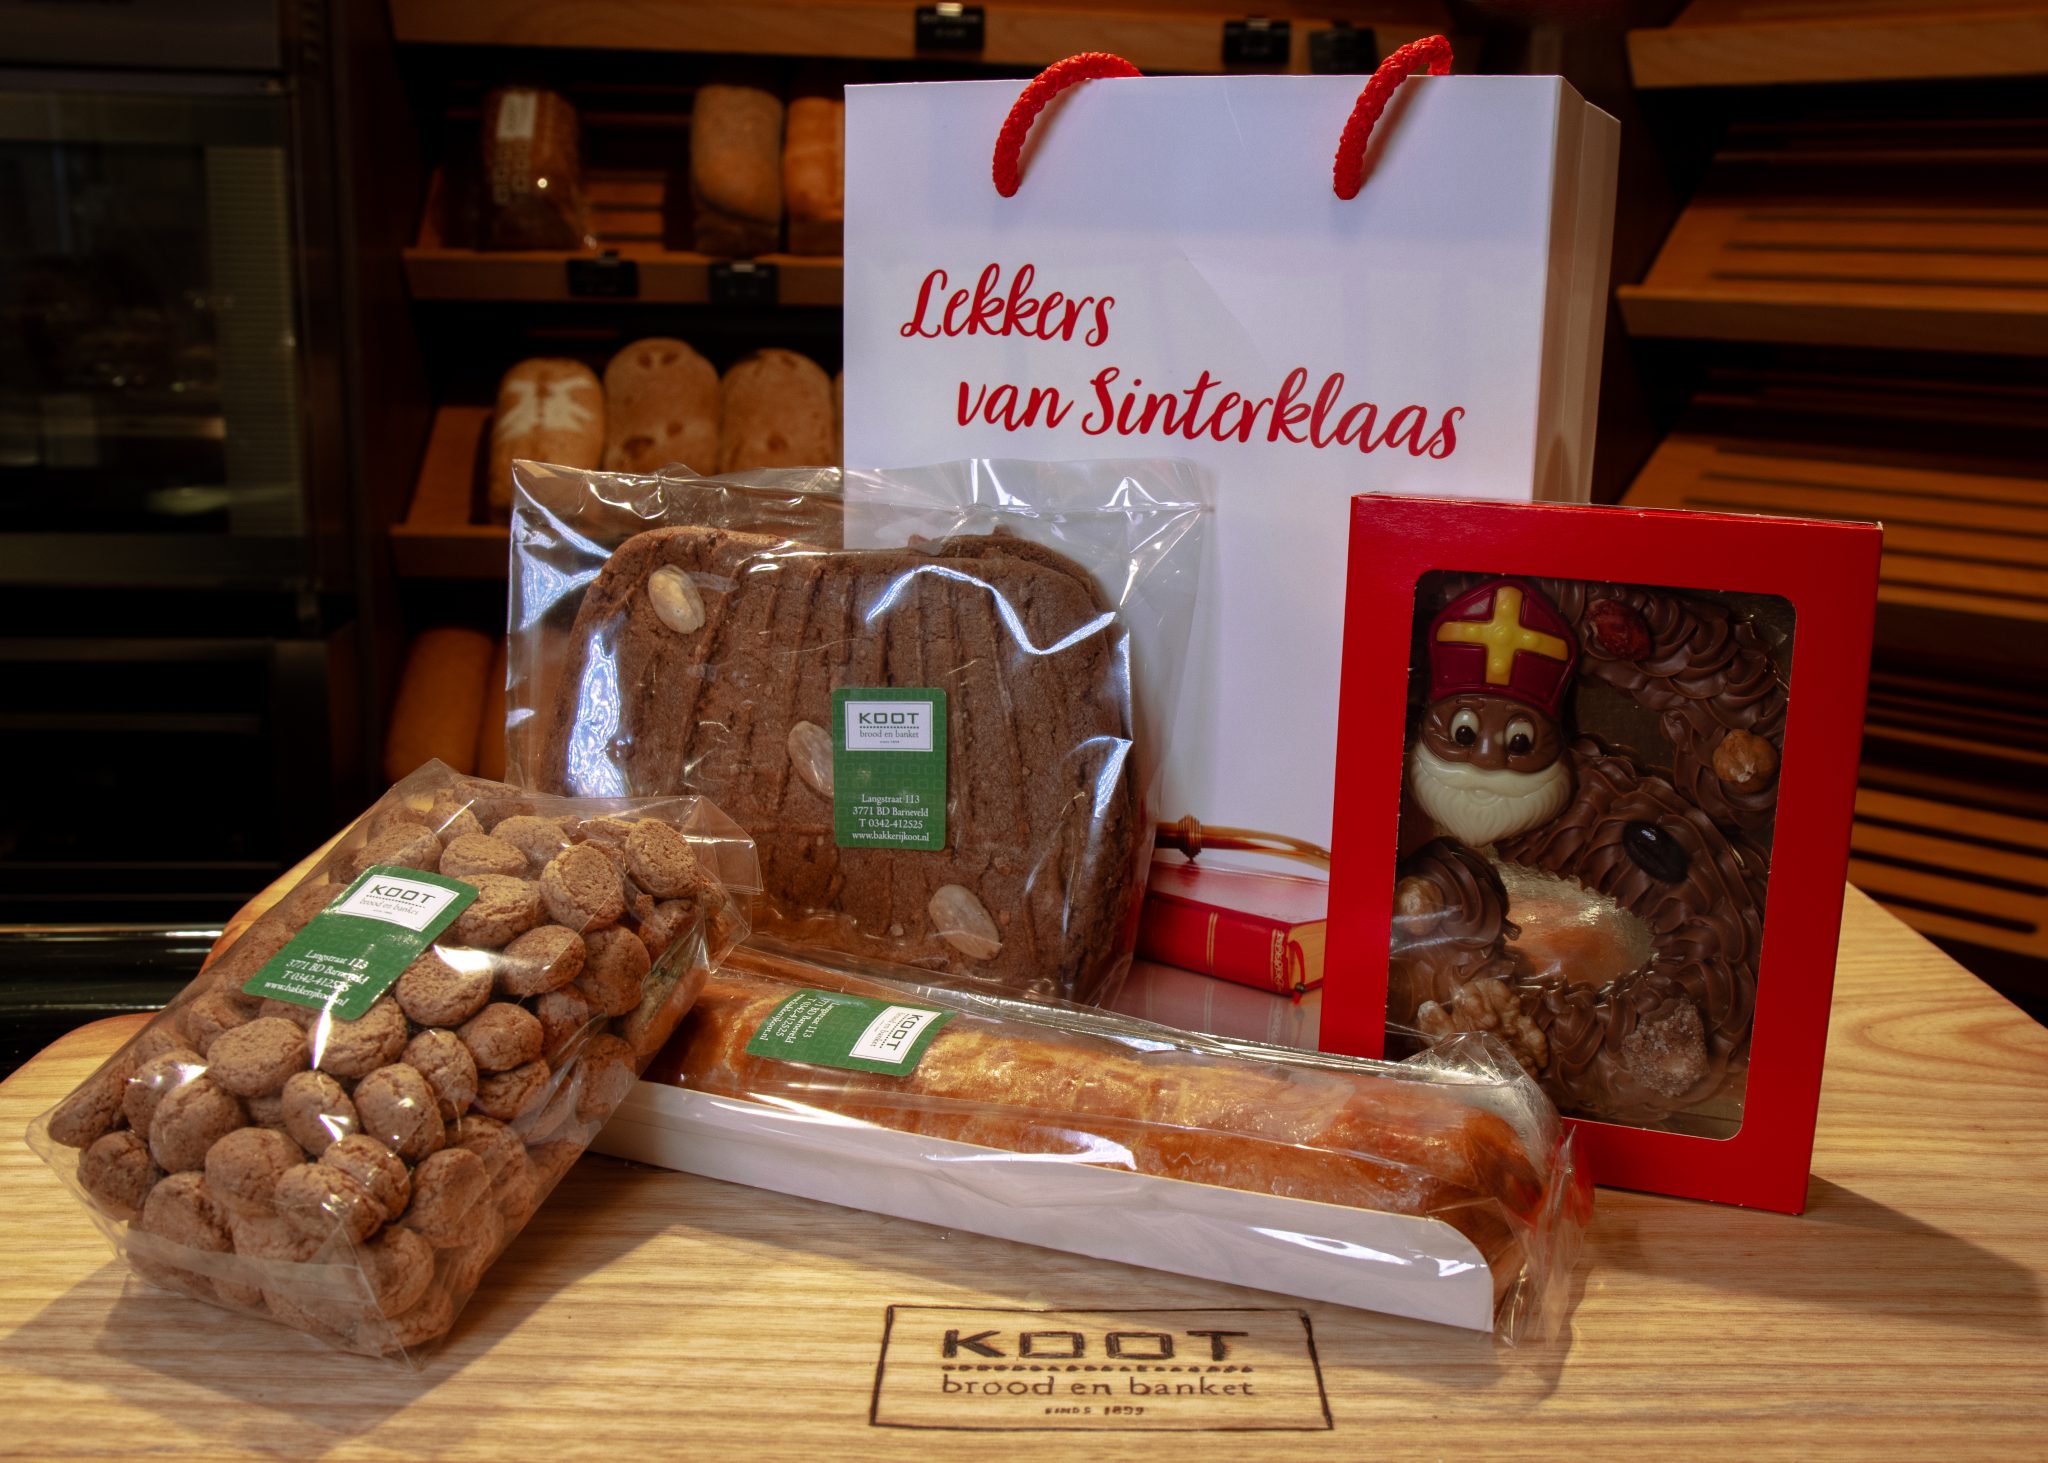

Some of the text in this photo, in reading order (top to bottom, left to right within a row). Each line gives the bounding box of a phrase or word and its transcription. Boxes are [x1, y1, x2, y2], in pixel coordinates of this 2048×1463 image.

[899, 262, 1115, 347] Lekkers
[957, 366, 1465, 459] van Sinterklaas
[859, 712, 919, 724] KOOT
[860, 729, 882, 738] brood
[895, 729, 919, 738] banket
[861, 793, 920, 805] Langstraat 113
[852, 806, 929, 817] 3771 BD Barneveld
[858, 818, 923, 829] T 0342-412525
[852, 830, 929, 843] www.bakkerijkoot.nl
[370, 884, 436, 904] KOOT
[286, 958, 309, 969] 3771
[308, 962, 326, 972] BD
[281, 970, 293, 979] T
[802, 1025, 818, 1038] 113
[886, 1014, 924, 1051] KOOT
[941, 1329, 1249, 1361] KOOT
[942, 1373, 1255, 1396] brood en banket
